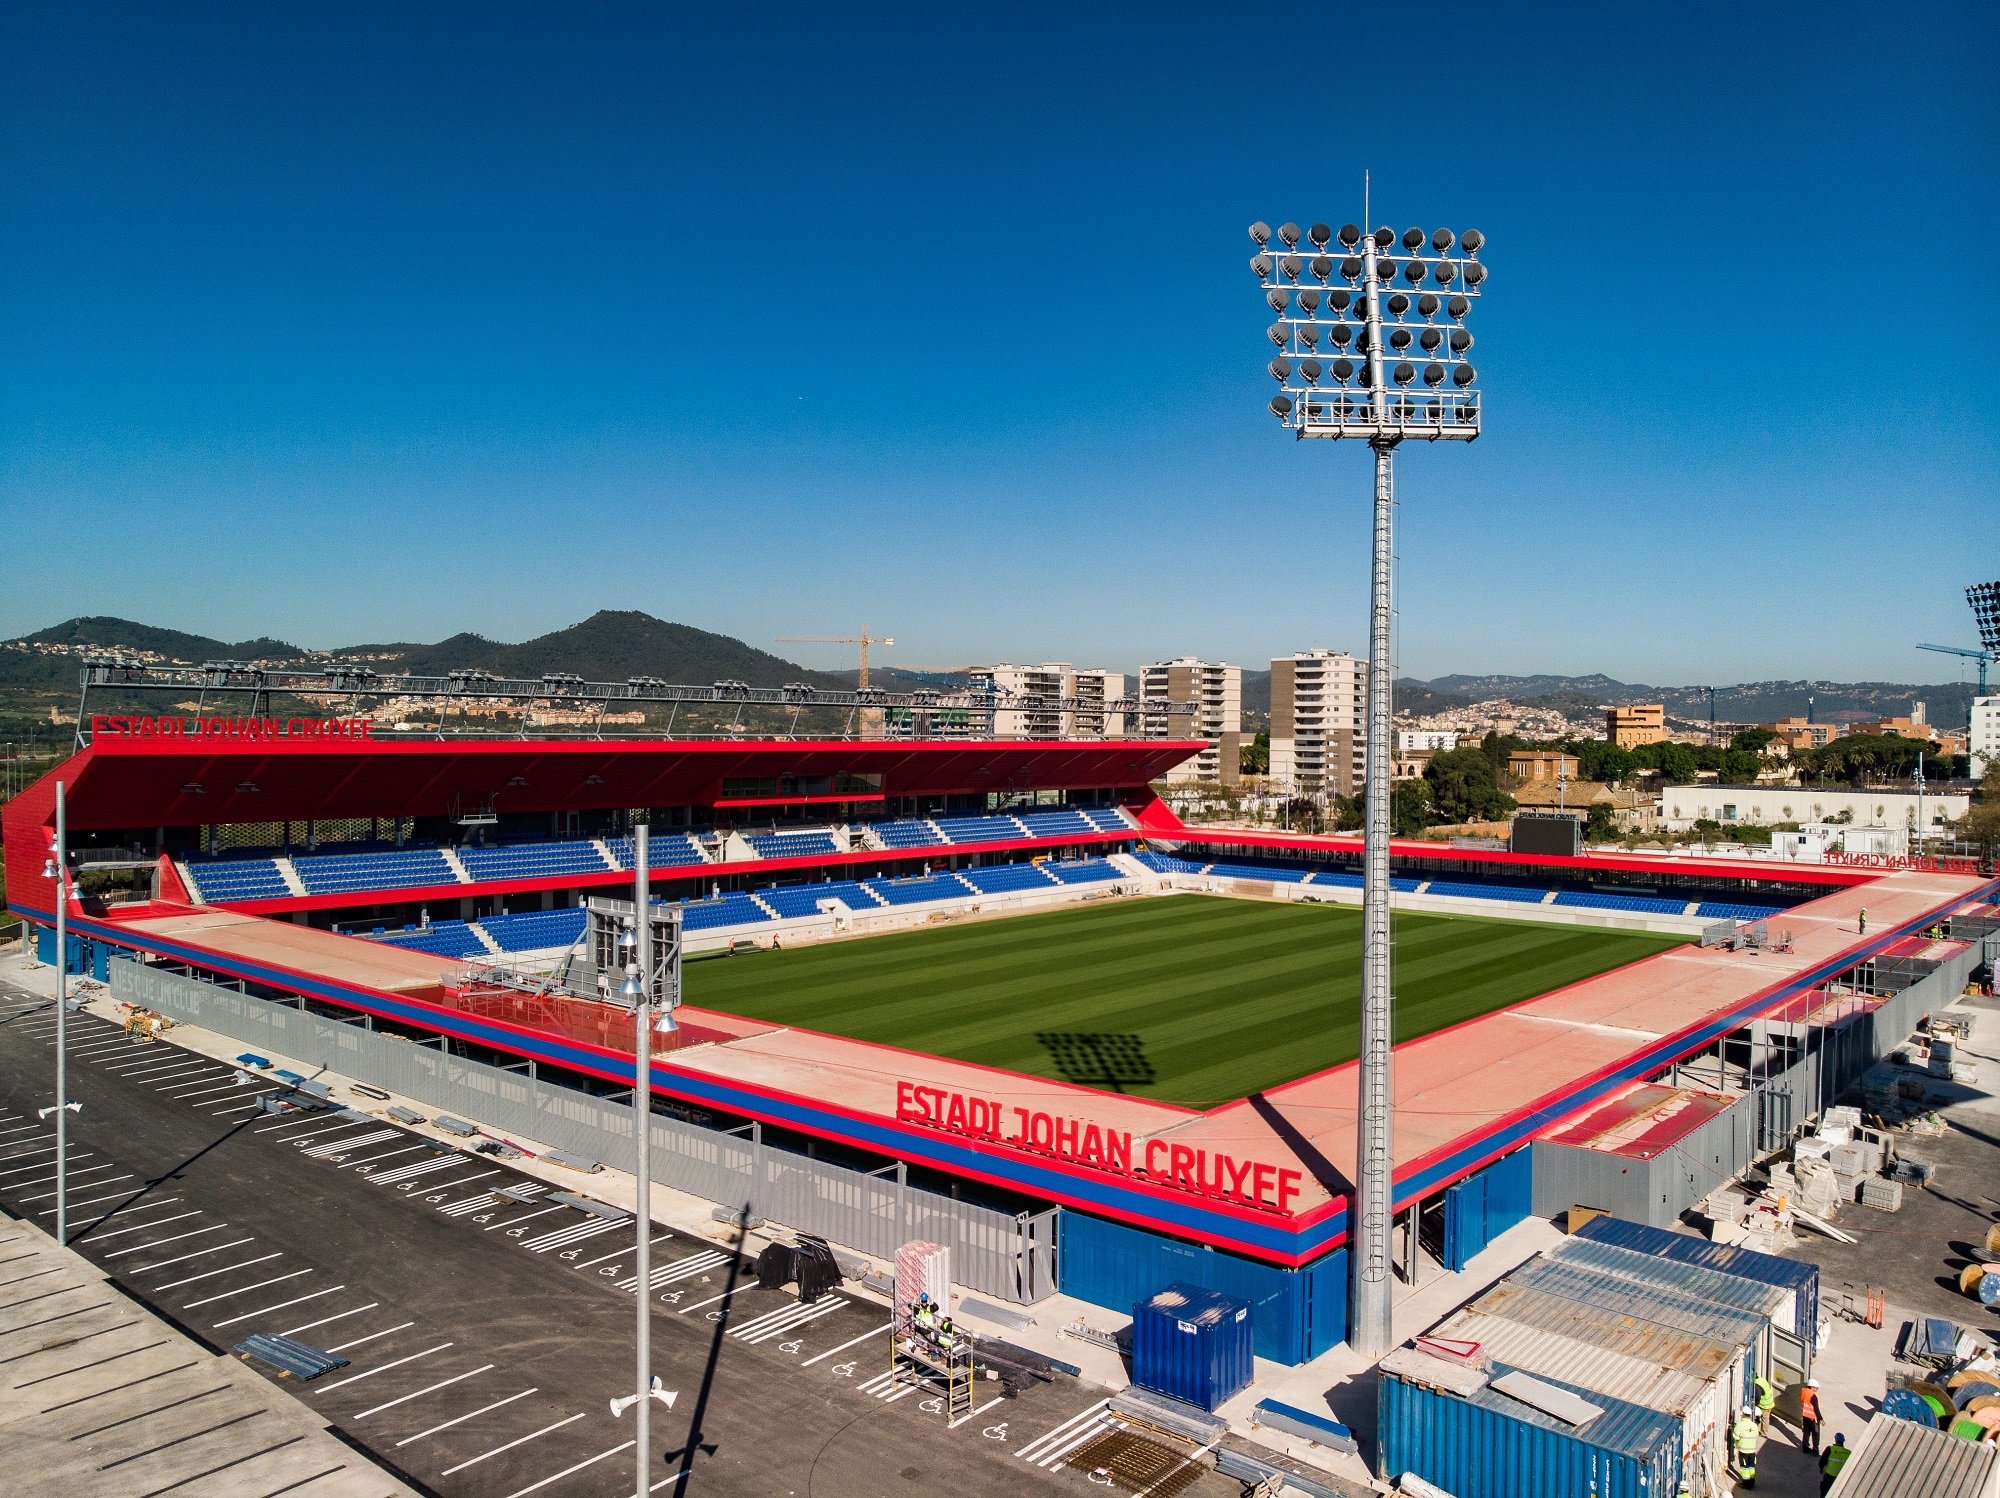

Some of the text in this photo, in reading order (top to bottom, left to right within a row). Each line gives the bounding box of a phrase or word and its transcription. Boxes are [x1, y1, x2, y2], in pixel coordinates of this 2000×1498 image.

[92, 715, 375, 740] ESTADI JOHAN CRUYFF
[897, 1080, 1302, 1211] ESTADI JOHAN CRUYFF
